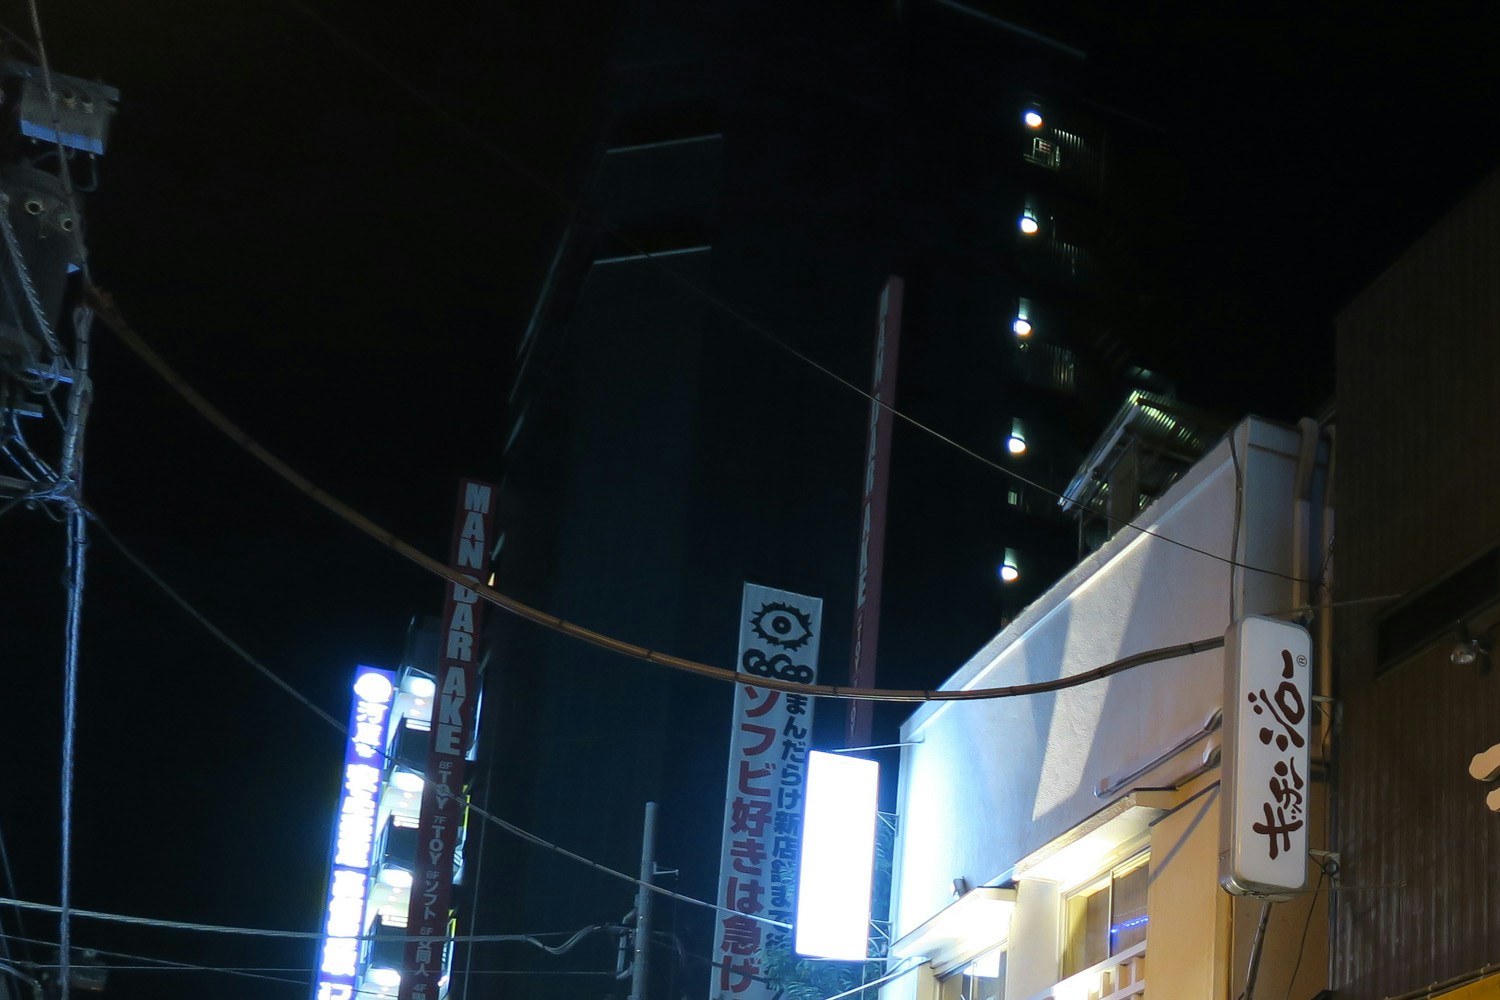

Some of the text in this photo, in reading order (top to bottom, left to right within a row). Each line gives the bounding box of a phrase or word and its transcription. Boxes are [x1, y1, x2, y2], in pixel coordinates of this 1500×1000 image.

[435, 482, 492, 755] MANDARAKE
[436, 770, 452, 809] TOY
[429, 825, 445, 865] TOY
[424, 881, 440, 920] ソフト
